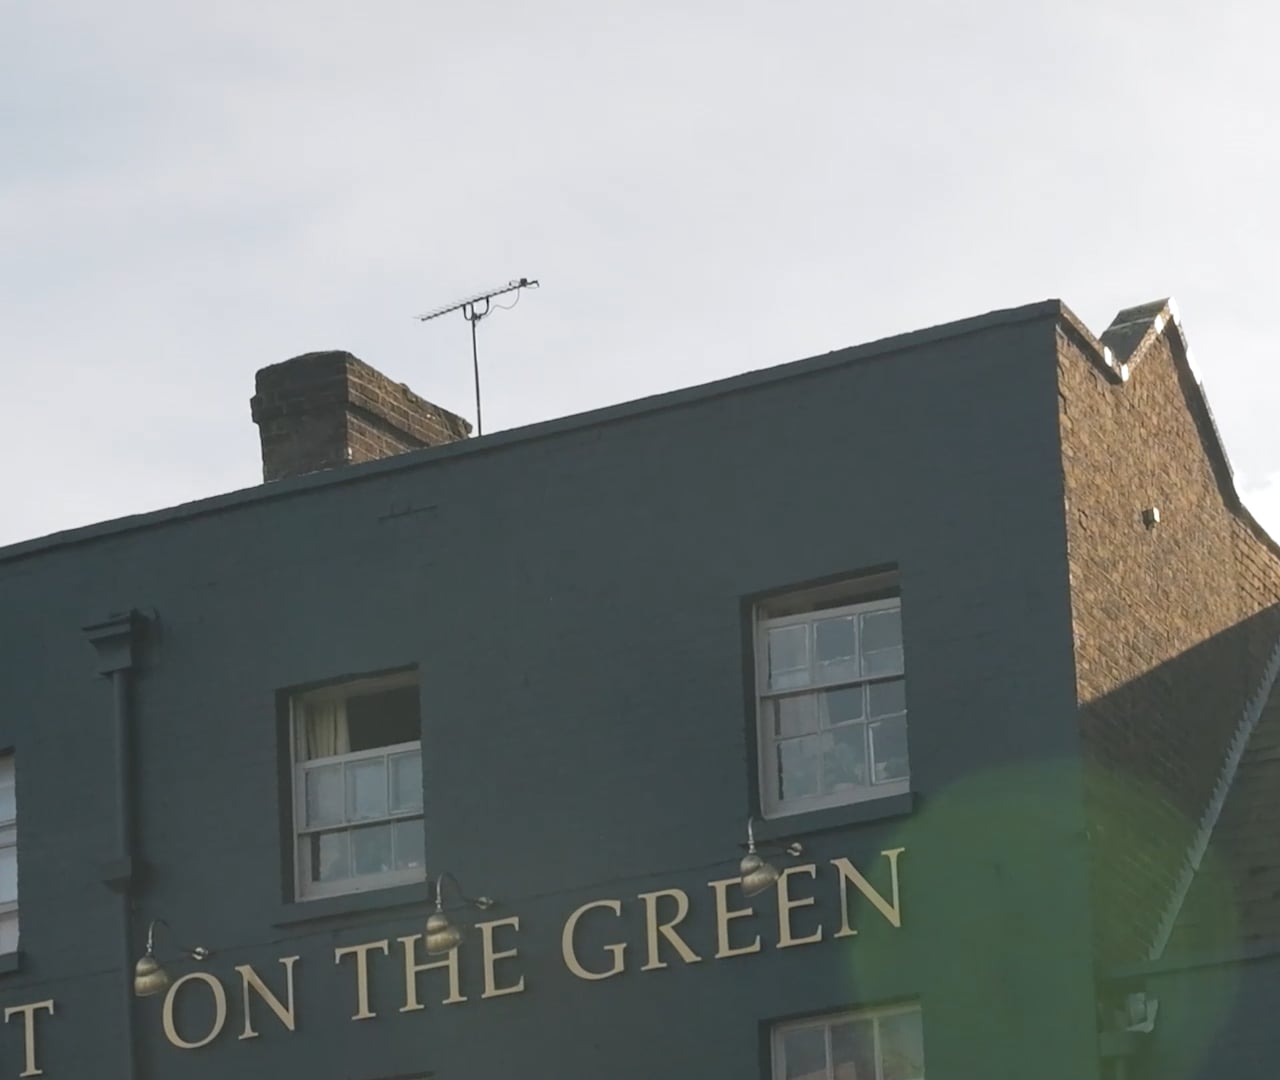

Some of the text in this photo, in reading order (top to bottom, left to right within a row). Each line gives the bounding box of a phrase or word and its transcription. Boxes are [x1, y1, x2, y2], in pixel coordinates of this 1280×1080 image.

[162, 956, 300, 1050] ON
[335, 916, 524, 1022] THE
[562, 847, 906, 981] GREEN
